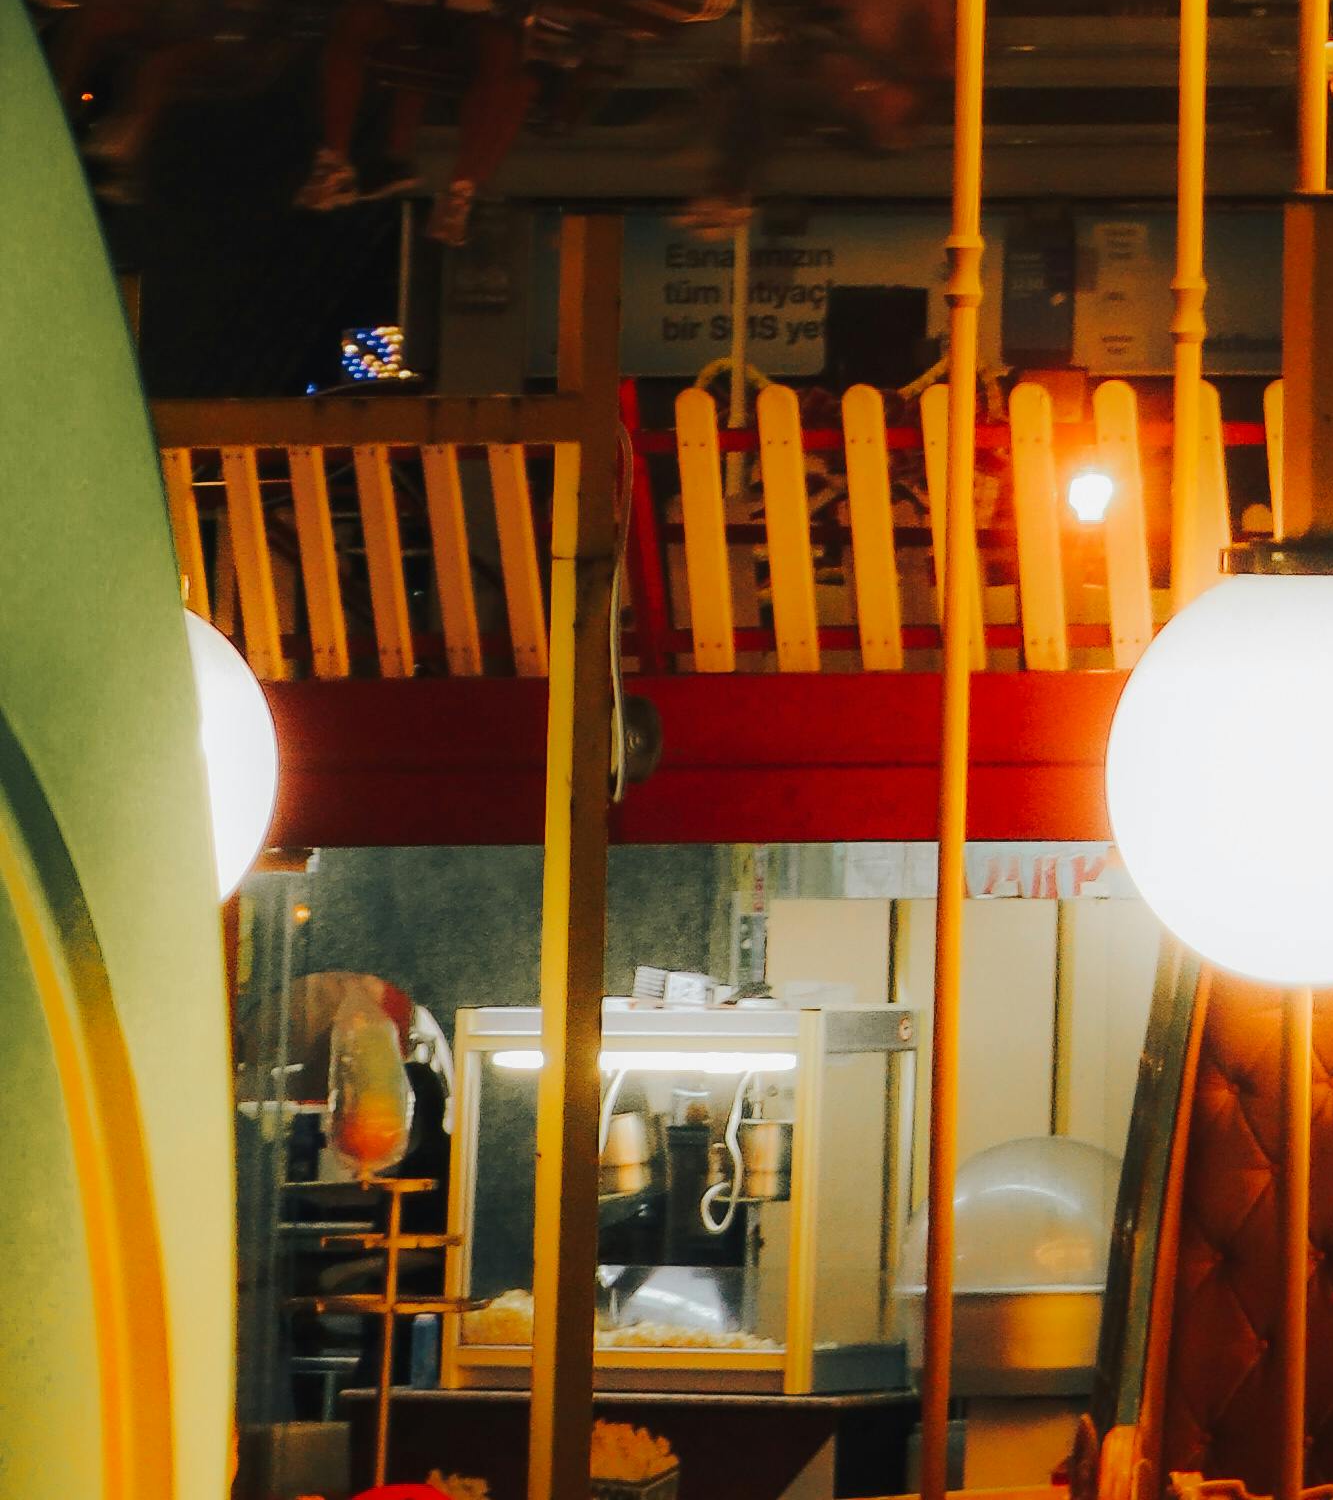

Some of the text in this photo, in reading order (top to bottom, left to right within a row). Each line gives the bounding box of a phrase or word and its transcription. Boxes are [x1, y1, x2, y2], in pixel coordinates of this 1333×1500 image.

[665, 243, 834, 268] Esnamızın
[663, 278, 835, 309] tüm itiyaç
[661, 315, 702, 341] bir
[785, 318, 825, 345] ye
